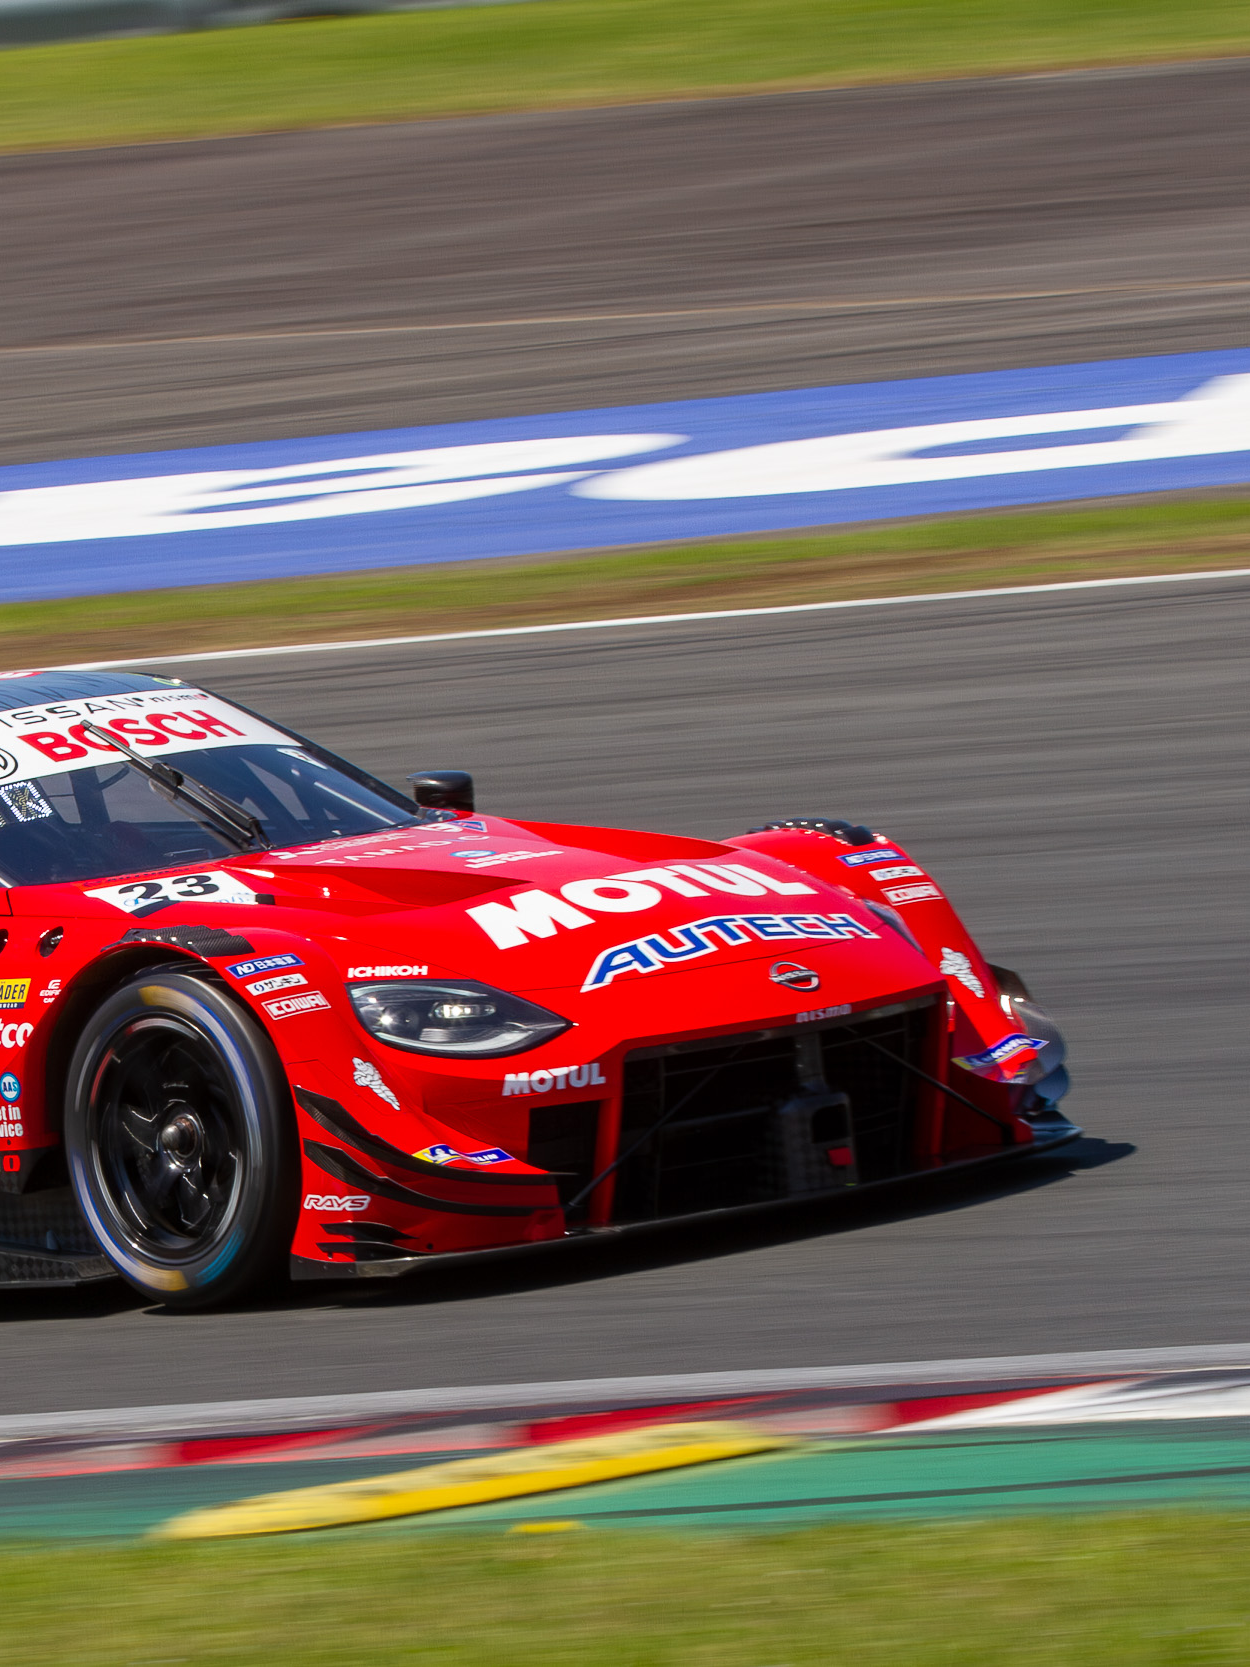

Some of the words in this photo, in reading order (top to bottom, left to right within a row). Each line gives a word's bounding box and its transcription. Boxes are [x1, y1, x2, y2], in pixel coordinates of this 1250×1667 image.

[17, 709, 248, 763] BOSCH
[118, 874, 220, 901] 23
[464, 863, 819, 951] MOTUL
[580, 913, 882, 993] AUTECH
[348, 965, 429, 979] ICHIKOH
[796, 1003, 852, 1023] nismo
[501, 1063, 607, 1097] MOTUL
[8, 1104, 22, 1121] in
[303, 1194, 371, 1212] RAYS
